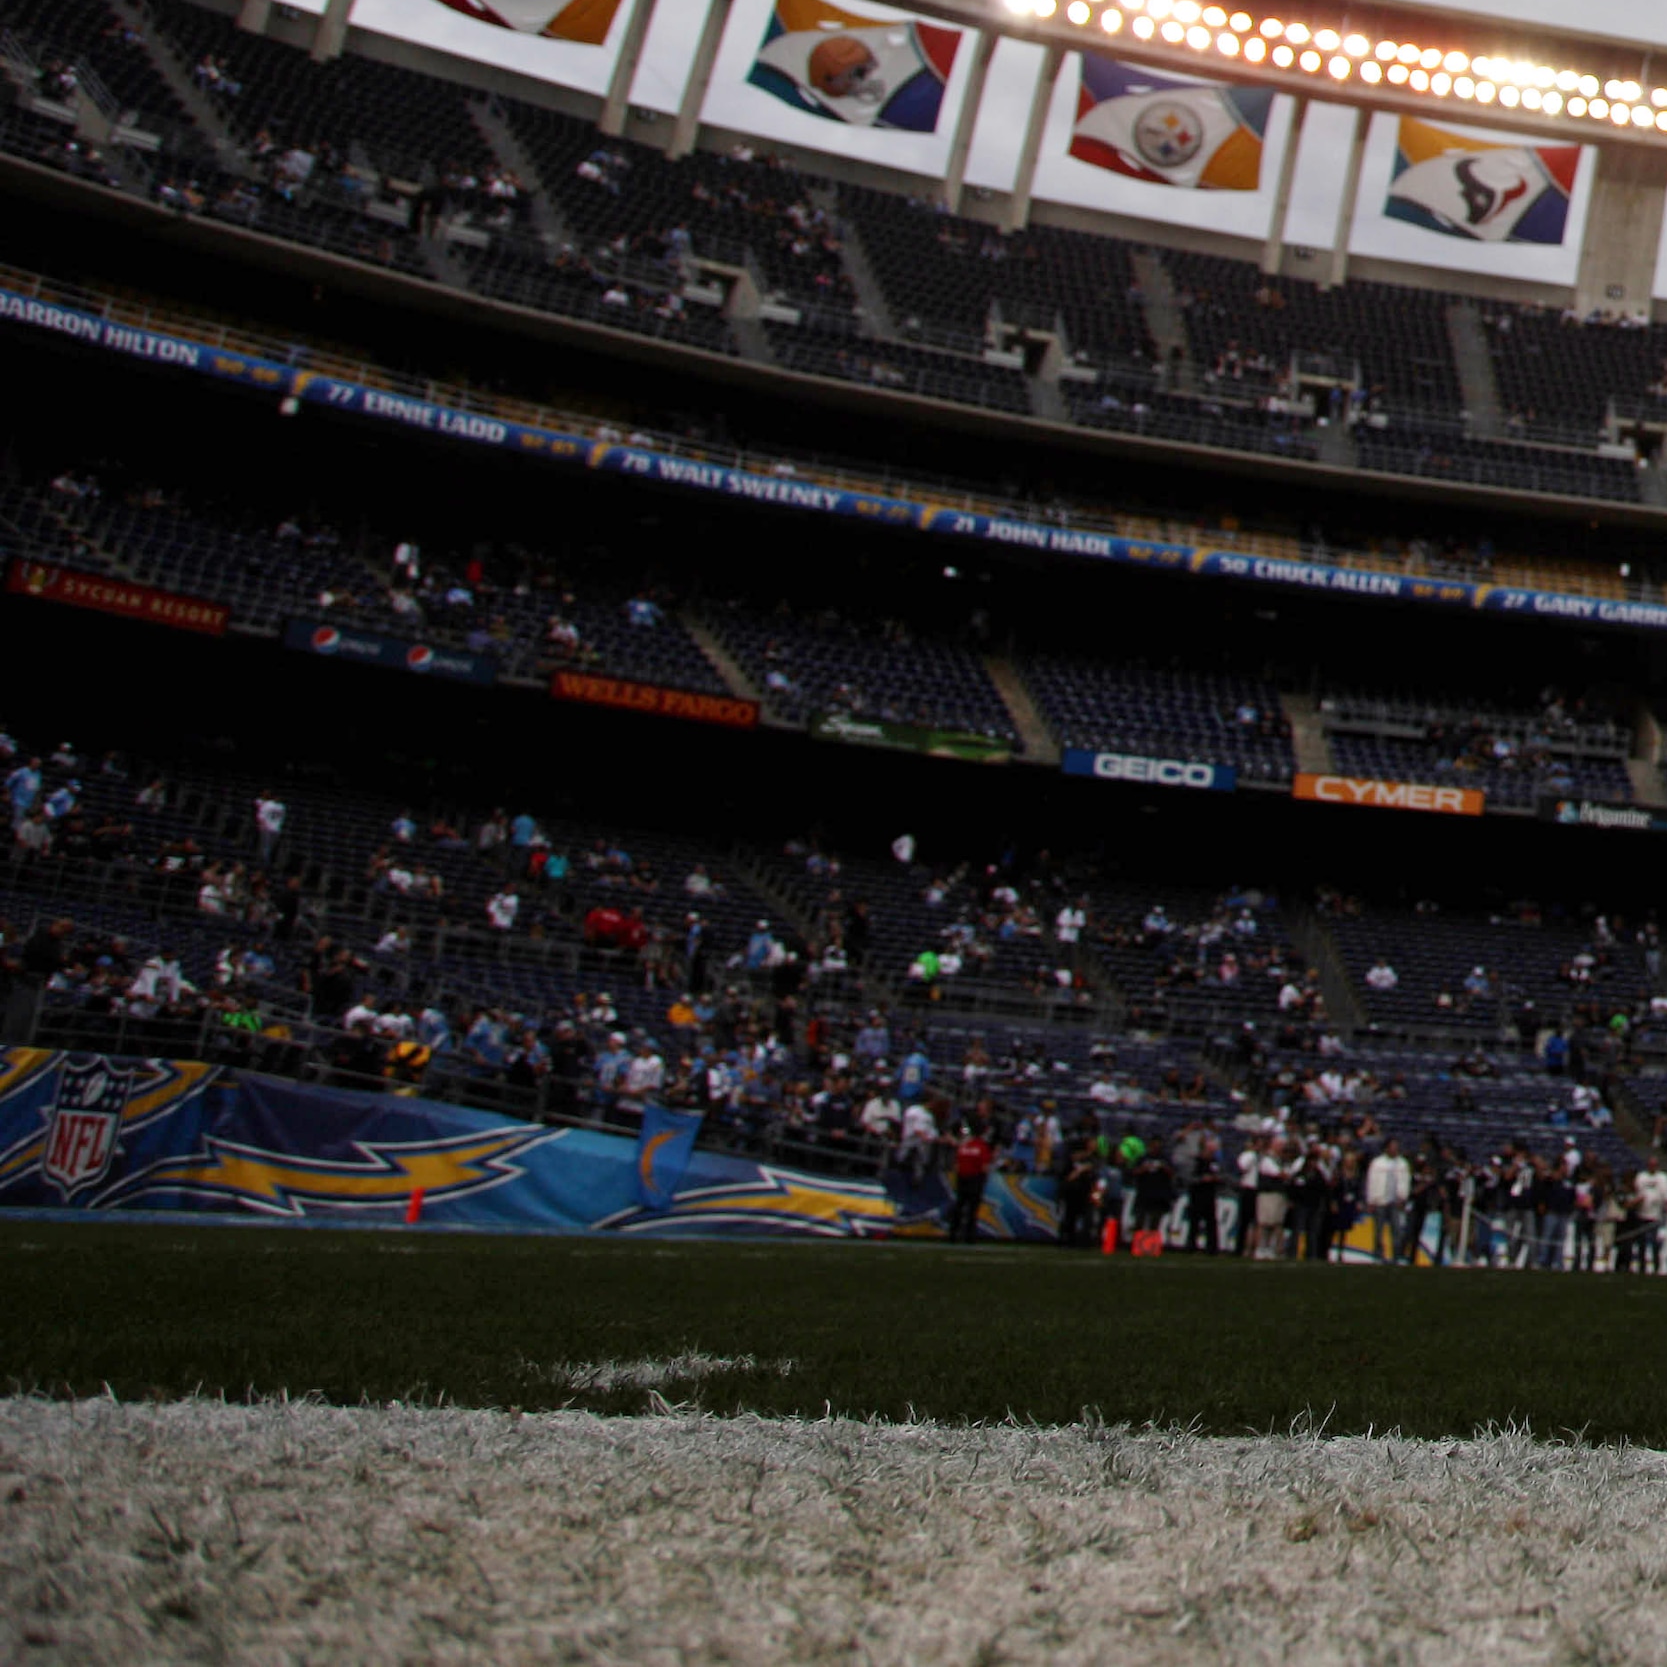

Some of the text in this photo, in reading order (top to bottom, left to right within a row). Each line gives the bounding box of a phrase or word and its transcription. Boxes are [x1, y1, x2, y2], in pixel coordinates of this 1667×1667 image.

[104, 325, 200, 367] HILTON
[327, 384, 508, 444] 77 ERNIE LADD
[656, 457, 723, 490] WALT
[726, 474, 840, 511] SWEENEY
[953, 514, 976, 533] 21
[984, 519, 1048, 549] JOHN
[1050, 533, 1114, 559] HADL
[1252, 558, 1327, 586] CHUCK
[1328, 570, 1402, 597] ALLEN
[149, 596, 225, 627] RESORT
[1533, 595, 1595, 619] GARY
[557, 672, 756, 727] WELLS FARGO
[1092, 752, 1214, 788] GEICO
[1314, 775, 1465, 812] CYMER
[49, 1113, 109, 1177] NFL
